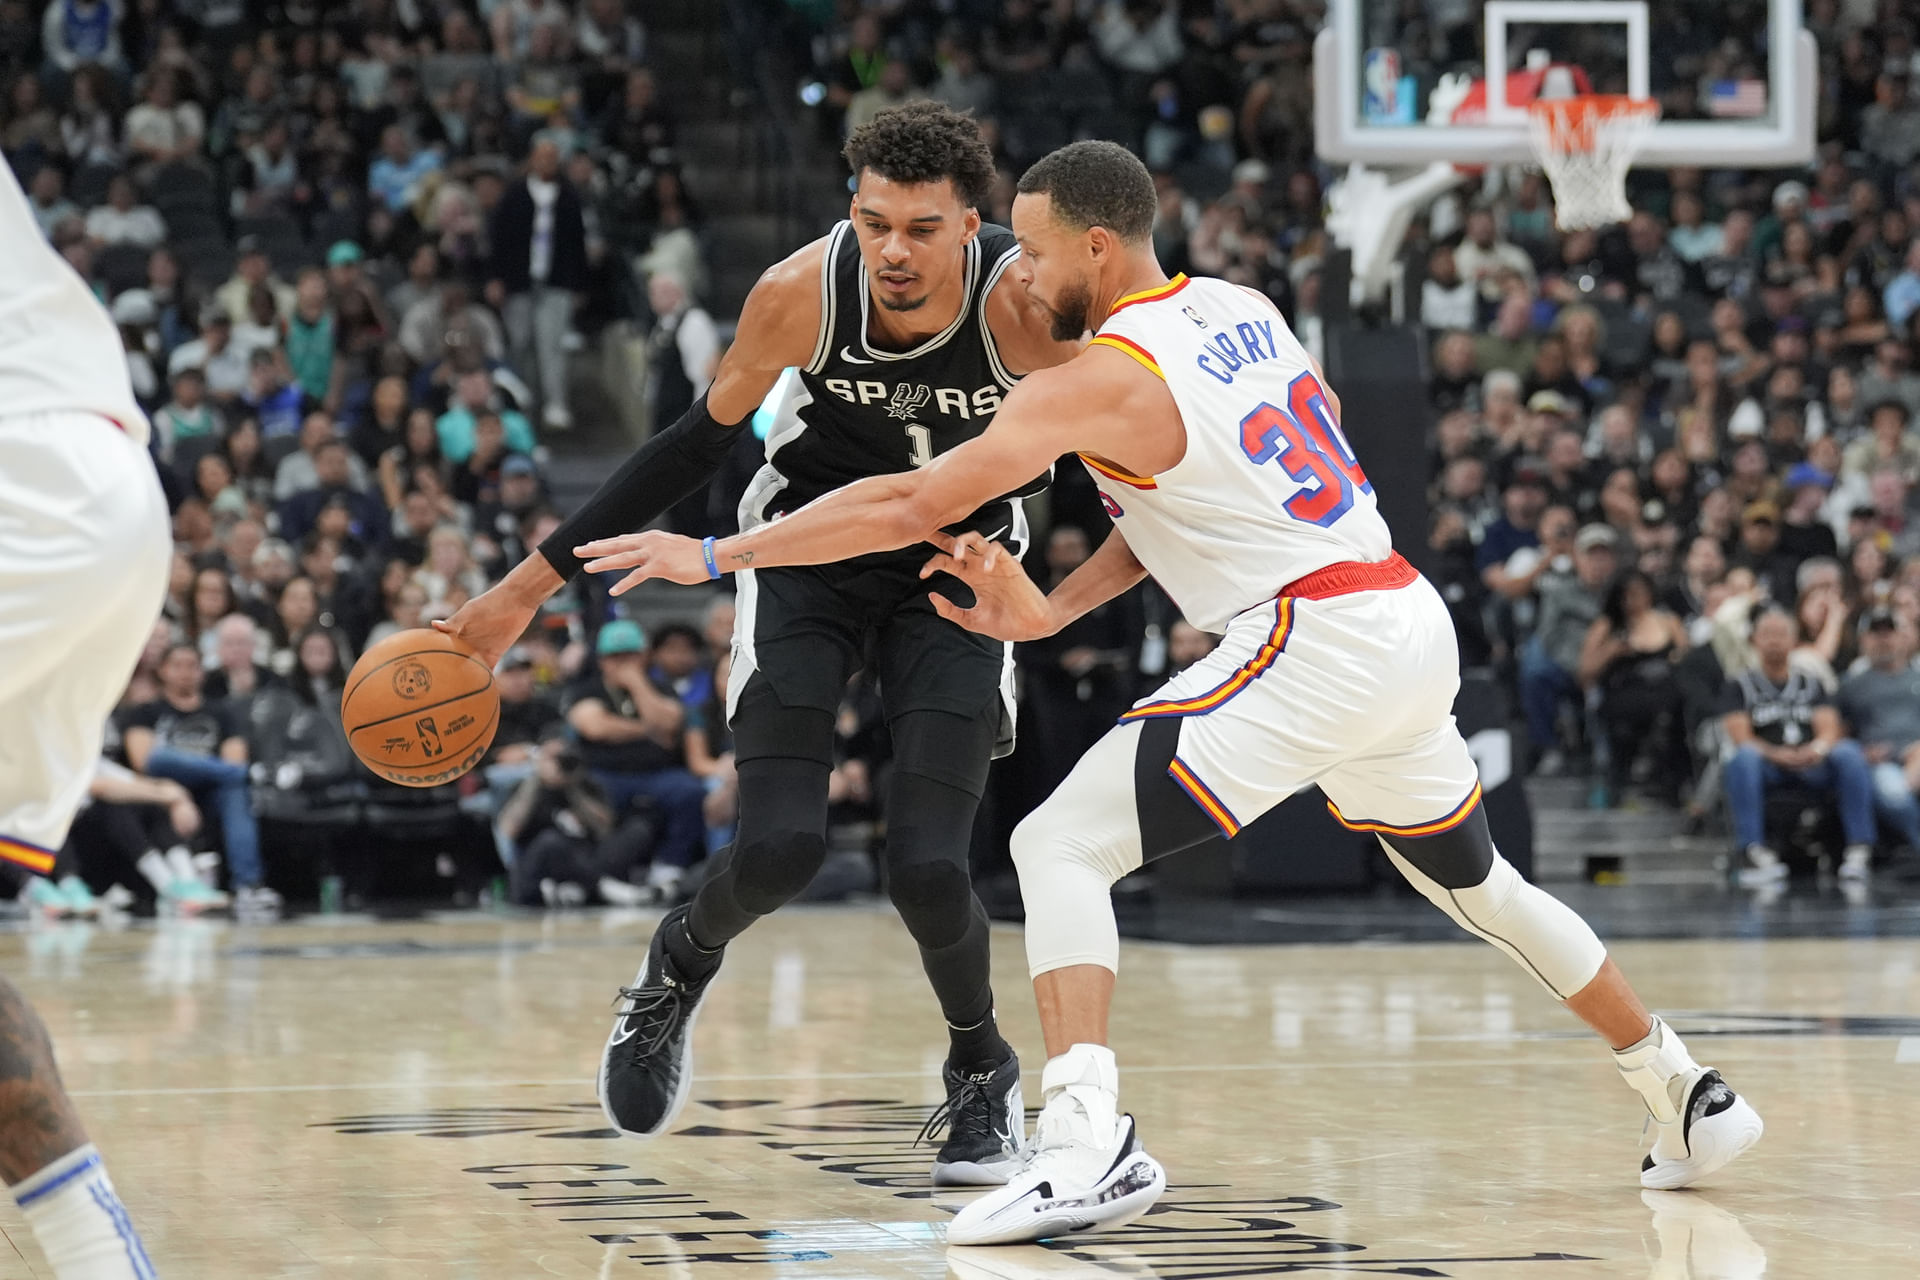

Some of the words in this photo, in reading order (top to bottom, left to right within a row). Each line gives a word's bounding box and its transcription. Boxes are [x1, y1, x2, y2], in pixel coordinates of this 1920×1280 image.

[1196, 320, 1279, 385] CURRY
[904, 422, 933, 468] 1
[1239, 369, 1373, 529] 30
[459, 1162, 836, 1267] CENTER
